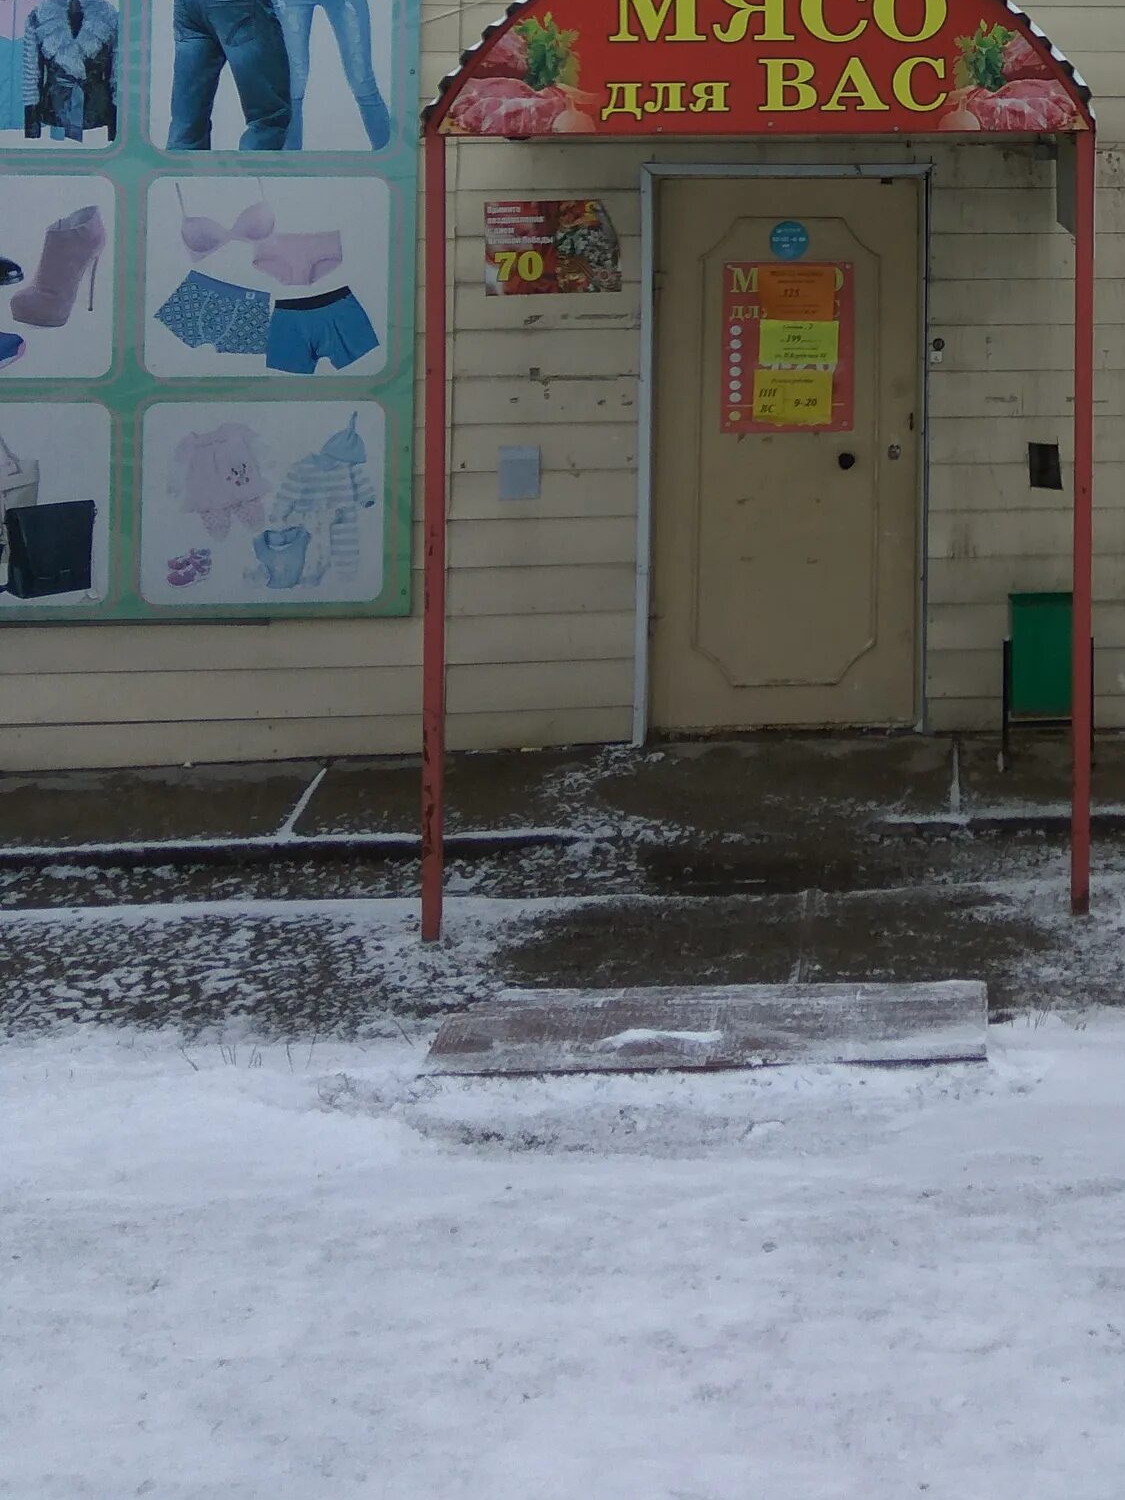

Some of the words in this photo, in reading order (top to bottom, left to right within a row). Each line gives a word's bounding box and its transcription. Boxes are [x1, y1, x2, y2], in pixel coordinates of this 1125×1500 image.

[601, 81, 730, 121] для
[758, 57, 949, 112] ВАС
[494, 250, 544, 283] 70
